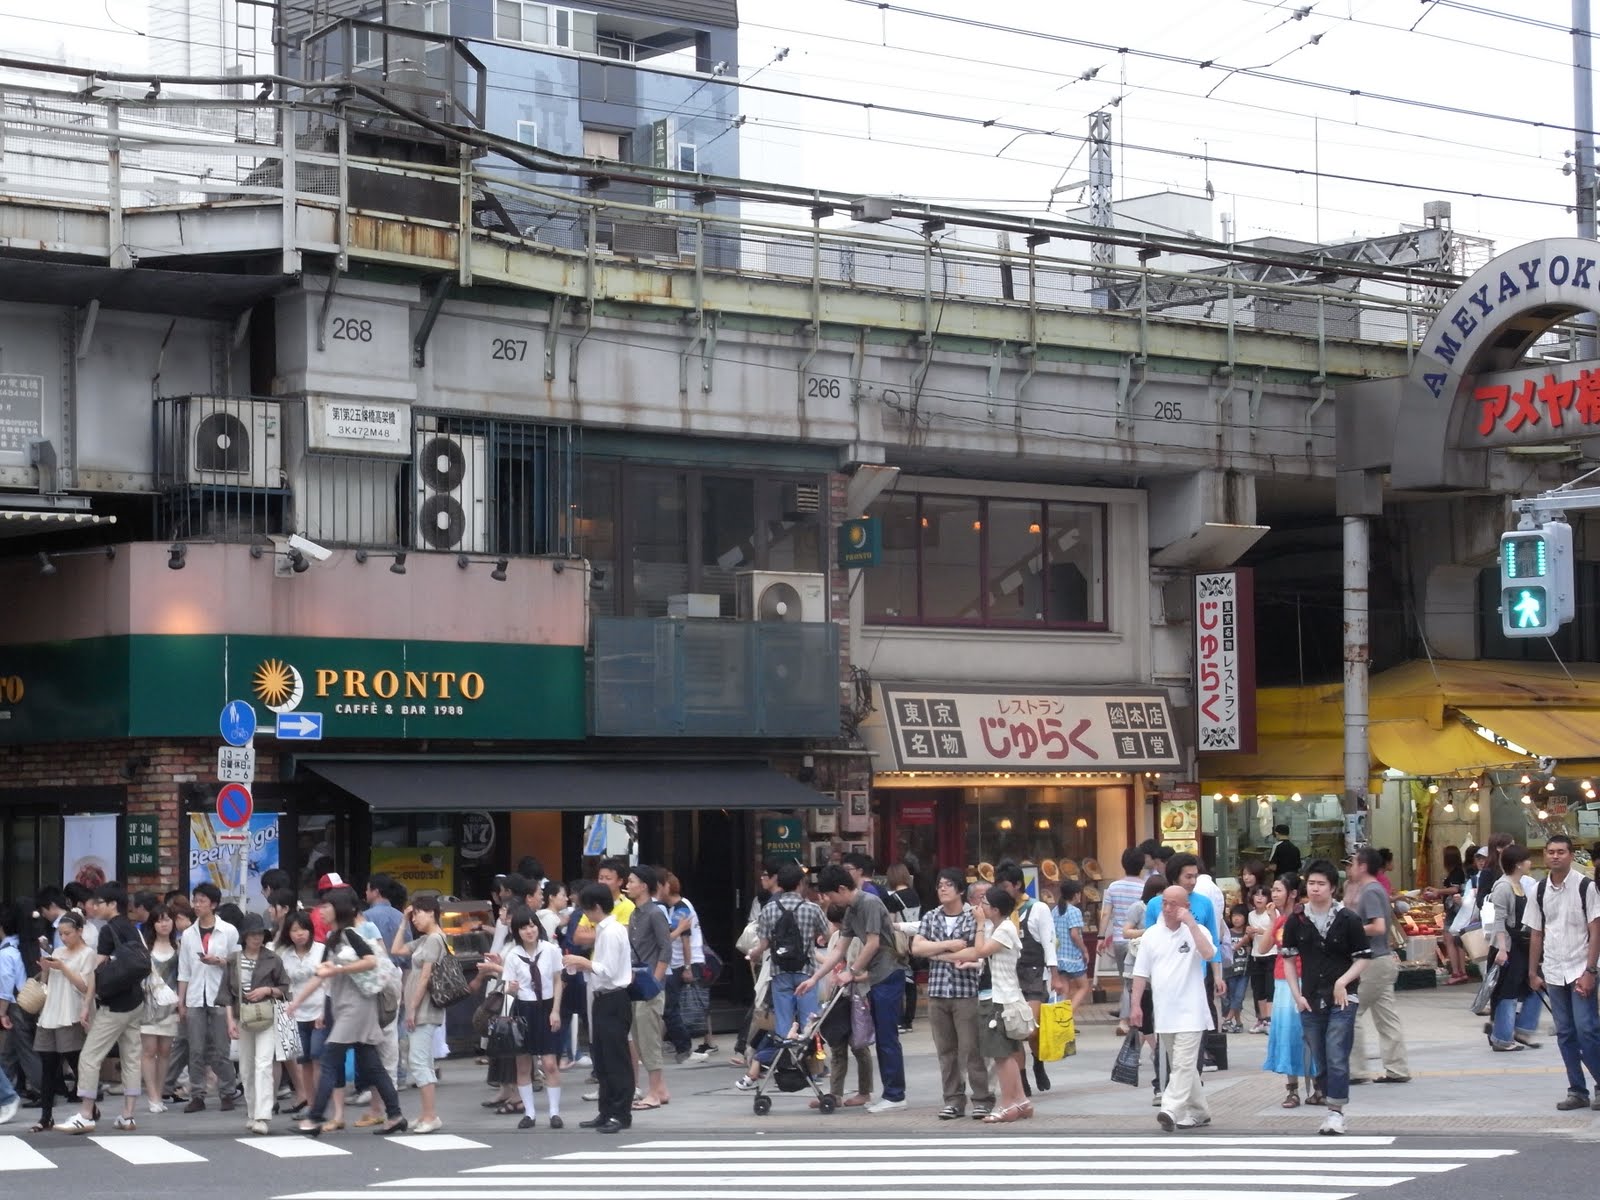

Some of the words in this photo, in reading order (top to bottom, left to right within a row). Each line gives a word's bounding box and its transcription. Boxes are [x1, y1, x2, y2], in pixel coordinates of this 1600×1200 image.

[332, 317, 372, 342] 268
[1423, 255, 1600, 399] AMEYAYOK
[492, 338, 528, 361] 267
[808, 377, 840, 399] 266
[1154, 401, 1183, 421] 265
[338, 425, 391, 438] 3K472M48
[1199, 601, 1220, 723] じゅらく
[315, 669, 486, 700] PRONTO
[335, 701, 378, 715] CAFFÈ
[384, 704, 393, 715] &
[401, 704, 427, 716] BAR
[434, 705, 464, 716] 1988
[903, 701, 953, 724] 東京
[997, 699, 1065, 716] レストラン
[1109, 706, 1163, 726] 総本店
[911, 732, 959, 755] 名物
[979, 716, 1099, 760] じゅらく
[1121, 735, 1165, 755] 直営
[190, 844, 226, 870] Beer
[767, 842, 801, 850] PRONTO
